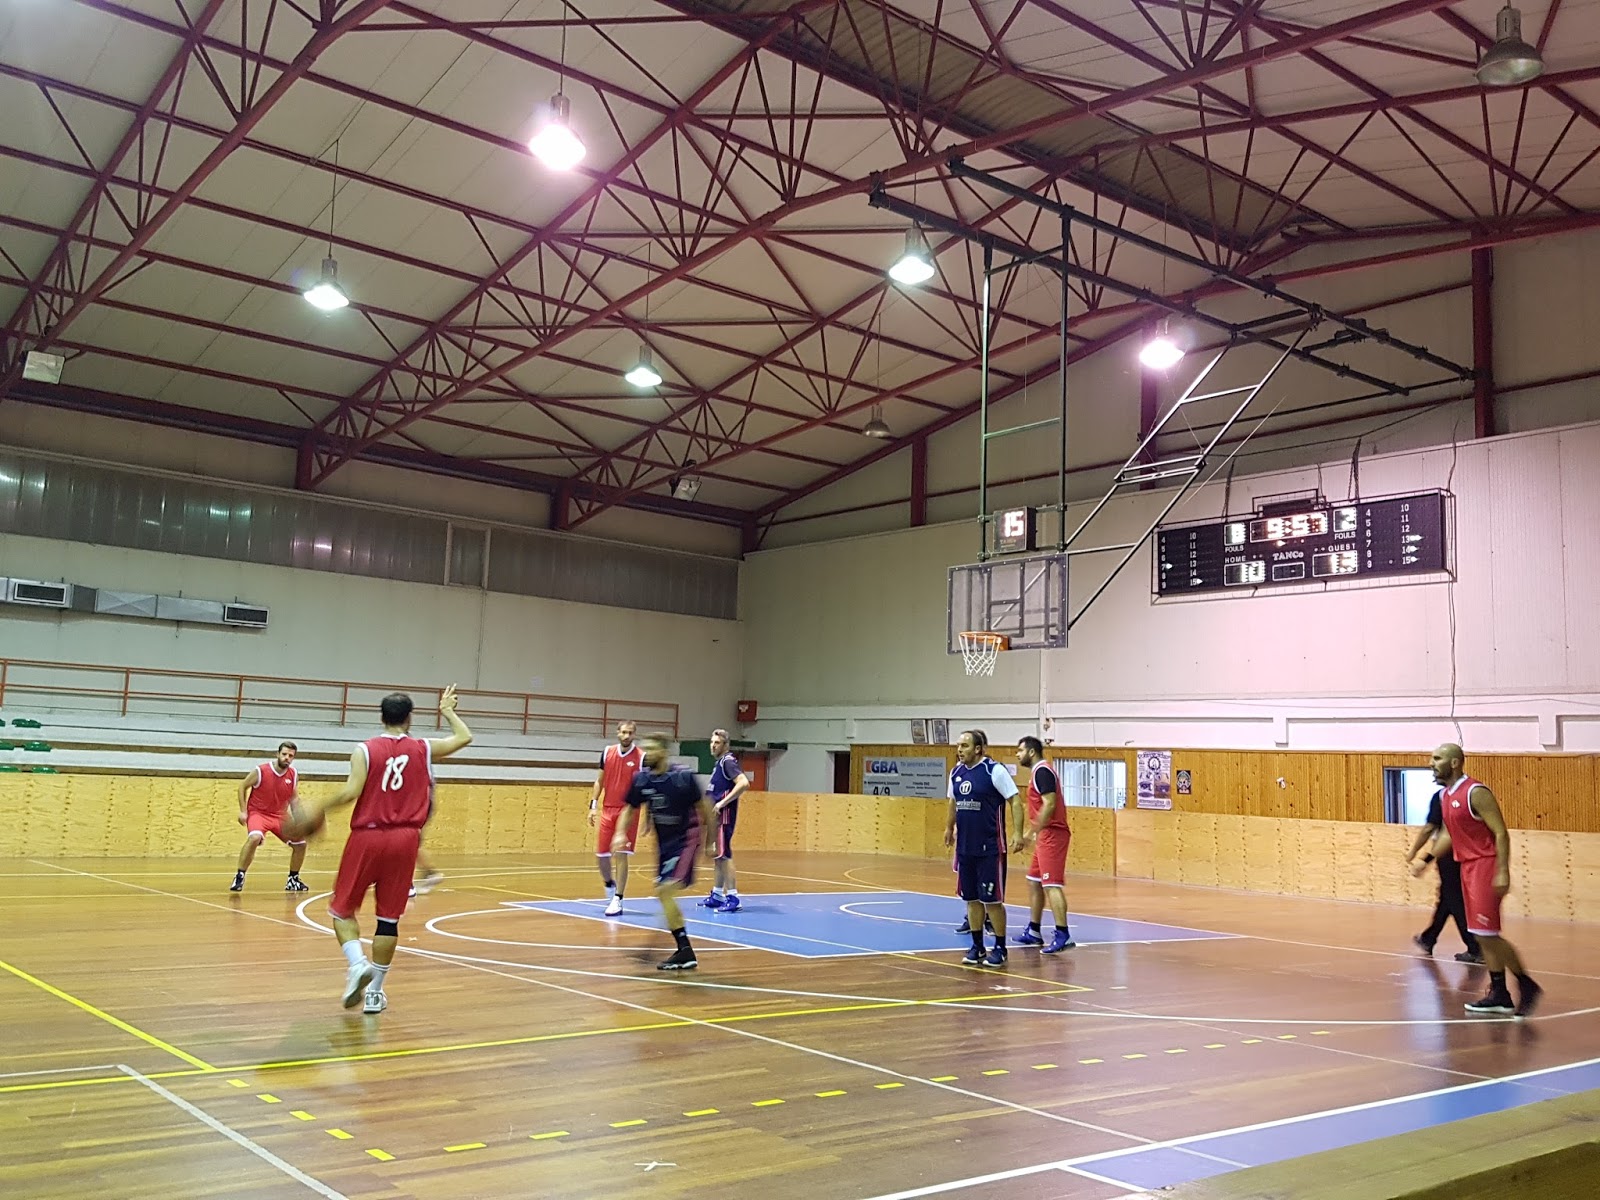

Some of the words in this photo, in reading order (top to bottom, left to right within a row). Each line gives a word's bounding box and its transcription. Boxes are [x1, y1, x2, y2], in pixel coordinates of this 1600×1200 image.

[1366, 508, 1371, 516] 4
[1401, 504, 1410, 512] 10
[1401, 514, 1409, 522] 11
[1402, 524, 1410, 532] 12
[1190, 532, 1197, 540] 10
[1334, 531, 1356, 540] FOULS
[1402, 535, 1410, 544] 13
[1190, 542, 1196, 550] 11
[1328, 543, 1356, 552] GUEST
[1366, 540, 1372, 548] 7
[1224, 544, 1244, 553] FOULS
[1190, 550, 1197, 558] 12
[1224, 555, 1246, 564] HOME
[1402, 556, 1411, 565] 15
[1190, 578, 1198, 586] 15
[381, 754, 409, 793] 18
